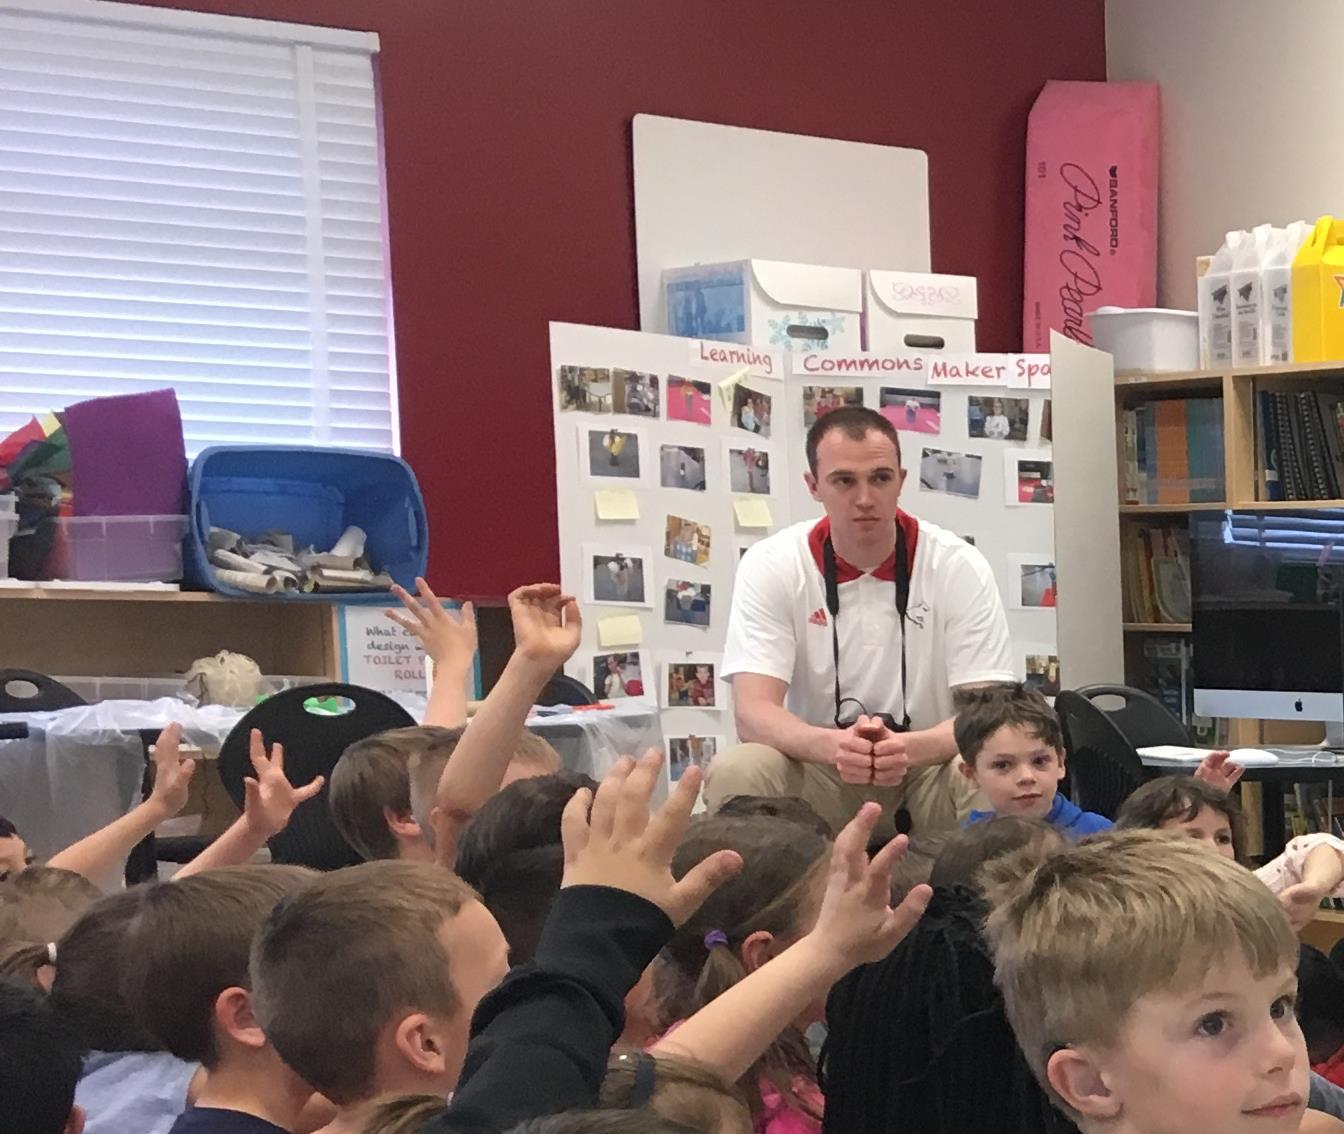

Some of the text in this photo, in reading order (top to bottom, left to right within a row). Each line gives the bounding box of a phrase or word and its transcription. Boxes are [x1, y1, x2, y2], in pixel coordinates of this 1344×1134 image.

[1060, 163, 1102, 257] Pink
[700, 342, 774, 375] Learning
[803, 354, 923, 373] Commons
[931, 362, 1007, 380] Maker
[366, 626, 398, 637] What
[367, 640, 410, 655] design
[363, 655, 412, 666] TOILET
